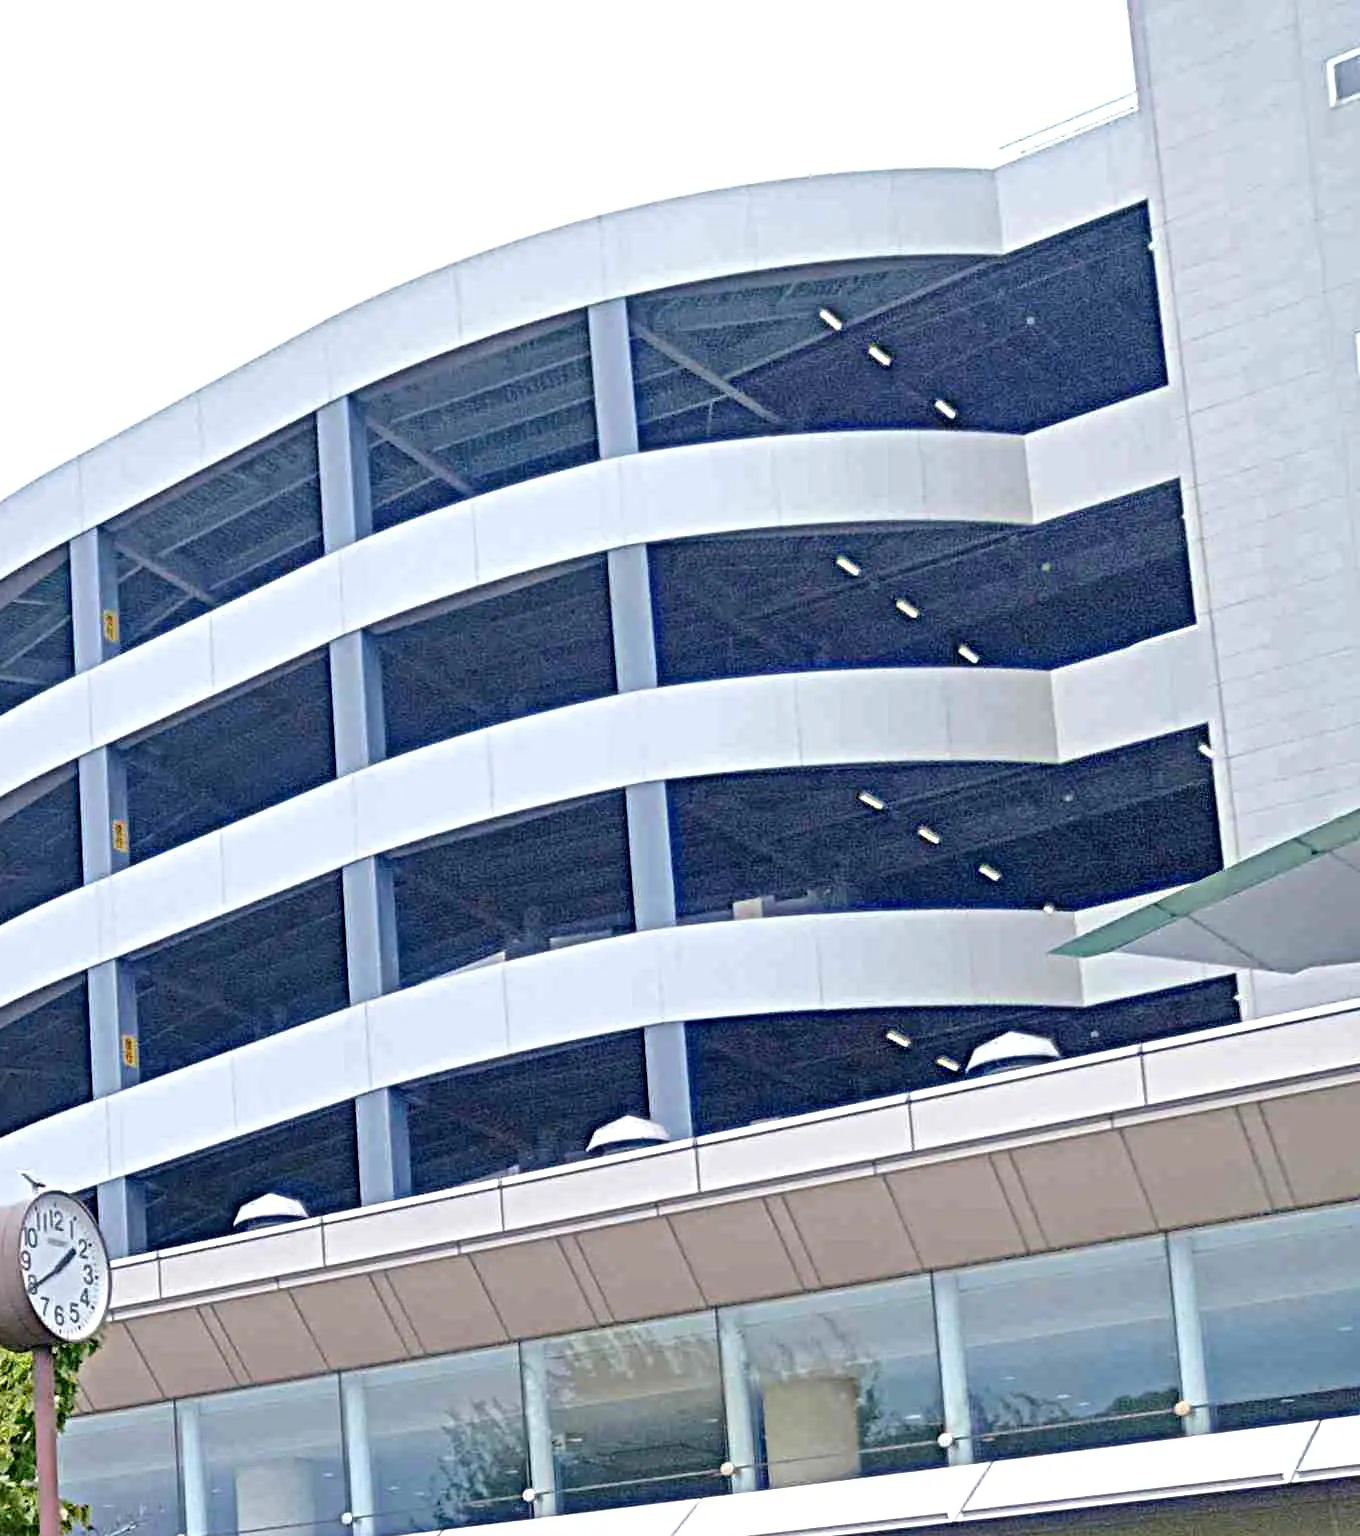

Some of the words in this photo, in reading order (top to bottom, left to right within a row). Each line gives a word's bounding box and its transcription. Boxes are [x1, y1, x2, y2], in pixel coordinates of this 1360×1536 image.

[36, 1210, 48, 1233] 11
[50, 1209, 64, 1231] 12
[23, 1226, 38, 1248] 10
[78, 1239, 88, 1259] 2
[21, 1251, 31, 1271] 9
[27, 1274, 38, 1295] 8
[83, 1264, 93, 1285] 3
[80, 1287, 90, 1305] 4
[40, 1297, 50, 1317] 7
[54, 1305, 65, 1326] 6
[69, 1302, 79, 1323] 5
